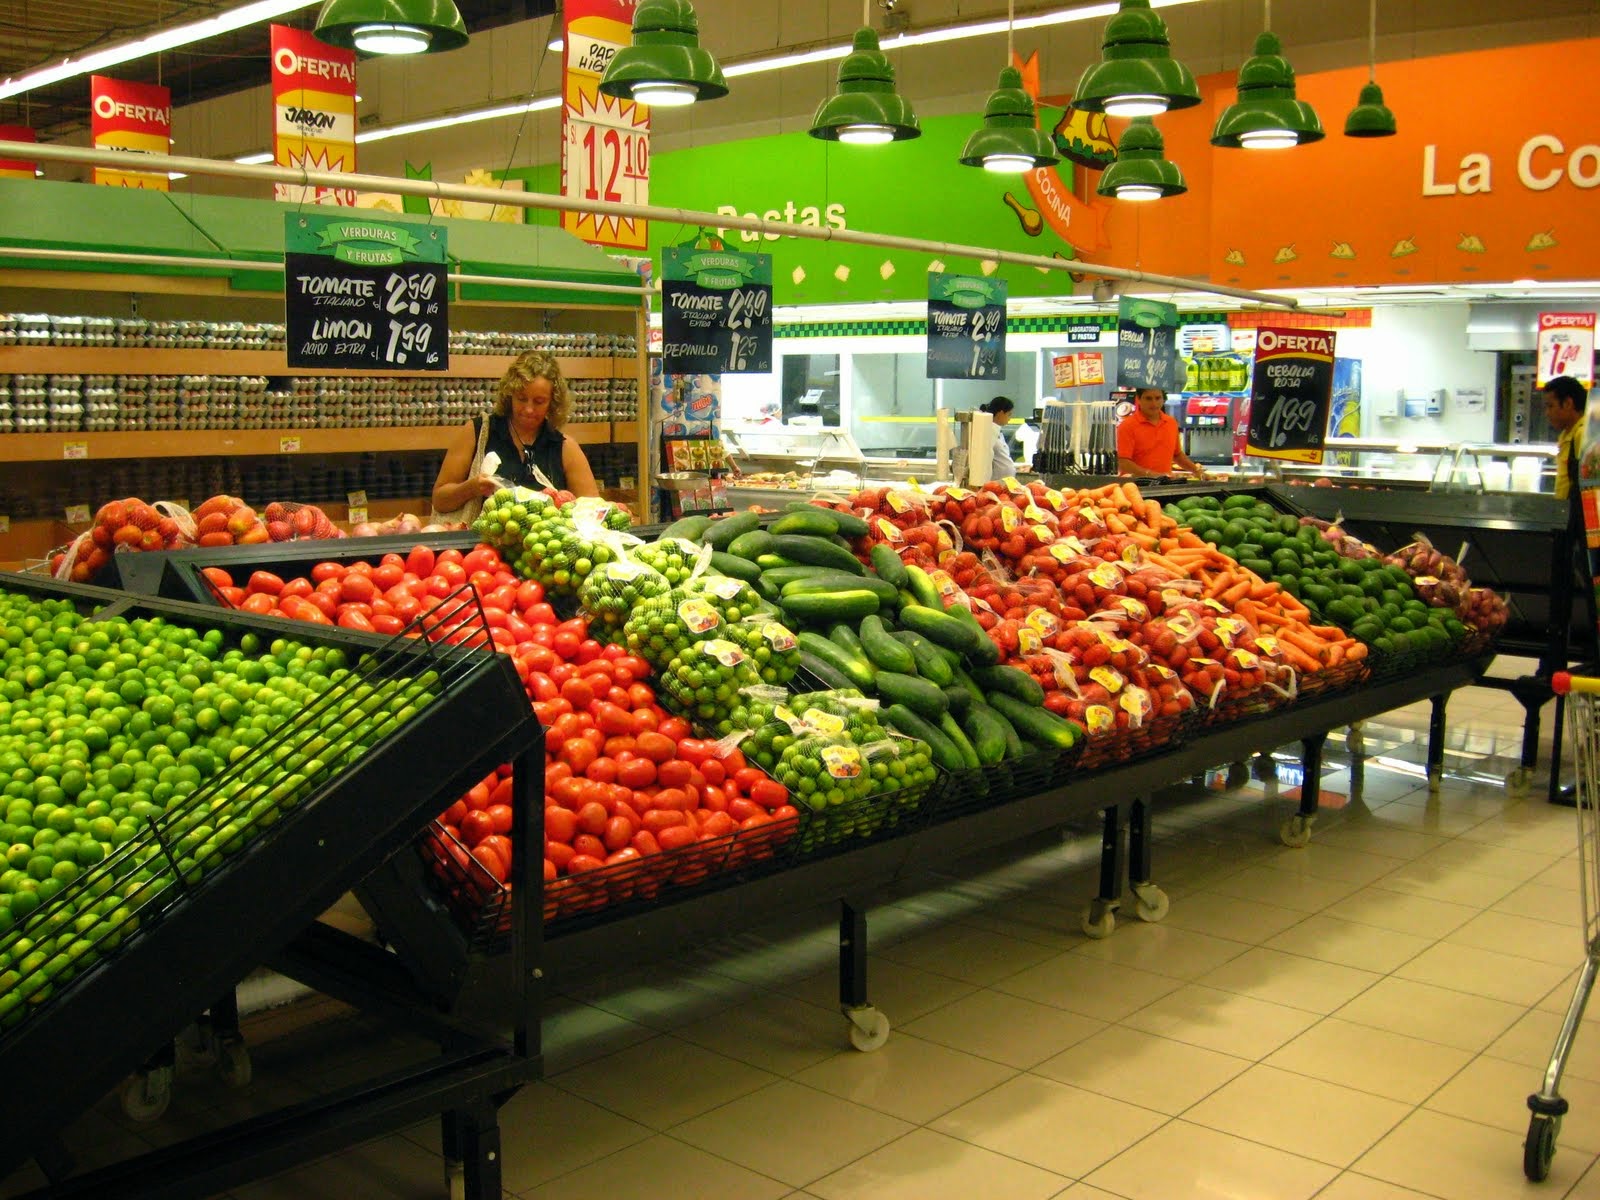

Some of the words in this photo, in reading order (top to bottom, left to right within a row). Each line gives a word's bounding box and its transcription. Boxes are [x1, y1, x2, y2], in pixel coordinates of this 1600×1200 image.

[275, 48, 356, 83] OFERTA!
[94, 95, 170, 126] OFERTA!
[285, 107, 336, 129] JABON
[1422, 144, 1492, 196] La
[1517, 134, 1600, 191] Co
[1036, 166, 1071, 227] COCINA
[717, 201, 847, 243] Pastas
[340, 226, 397, 241] VERDURAS
[346, 250, 353, 260] Y
[355, 251, 393, 263] FRUTAS
[700, 257, 740, 268] VERDURAS
[296, 276, 376, 298] TOMATE
[710, 277, 737, 287] FRUTAS
[312, 295, 366, 307] ITALIANO
[670, 292, 724, 311] TOMATE
[681, 310, 717, 320] ITALIANO
[931, 311, 968, 326] TOMATE
[1541, 314, 1594, 327] OFERTA!
[311, 316, 372, 341] LIMON
[689, 319, 712, 328] EXTRA
[1068, 325, 1100, 333] LABORATORIO
[334, 342, 367, 355] EXTRA
[1257, 331, 1335, 354] OFERTA!
[663, 343, 719, 359] PEPINILLO
[1267, 364, 1316, 378] CEBOLLA
[1273, 377, 1301, 388] ROJA
